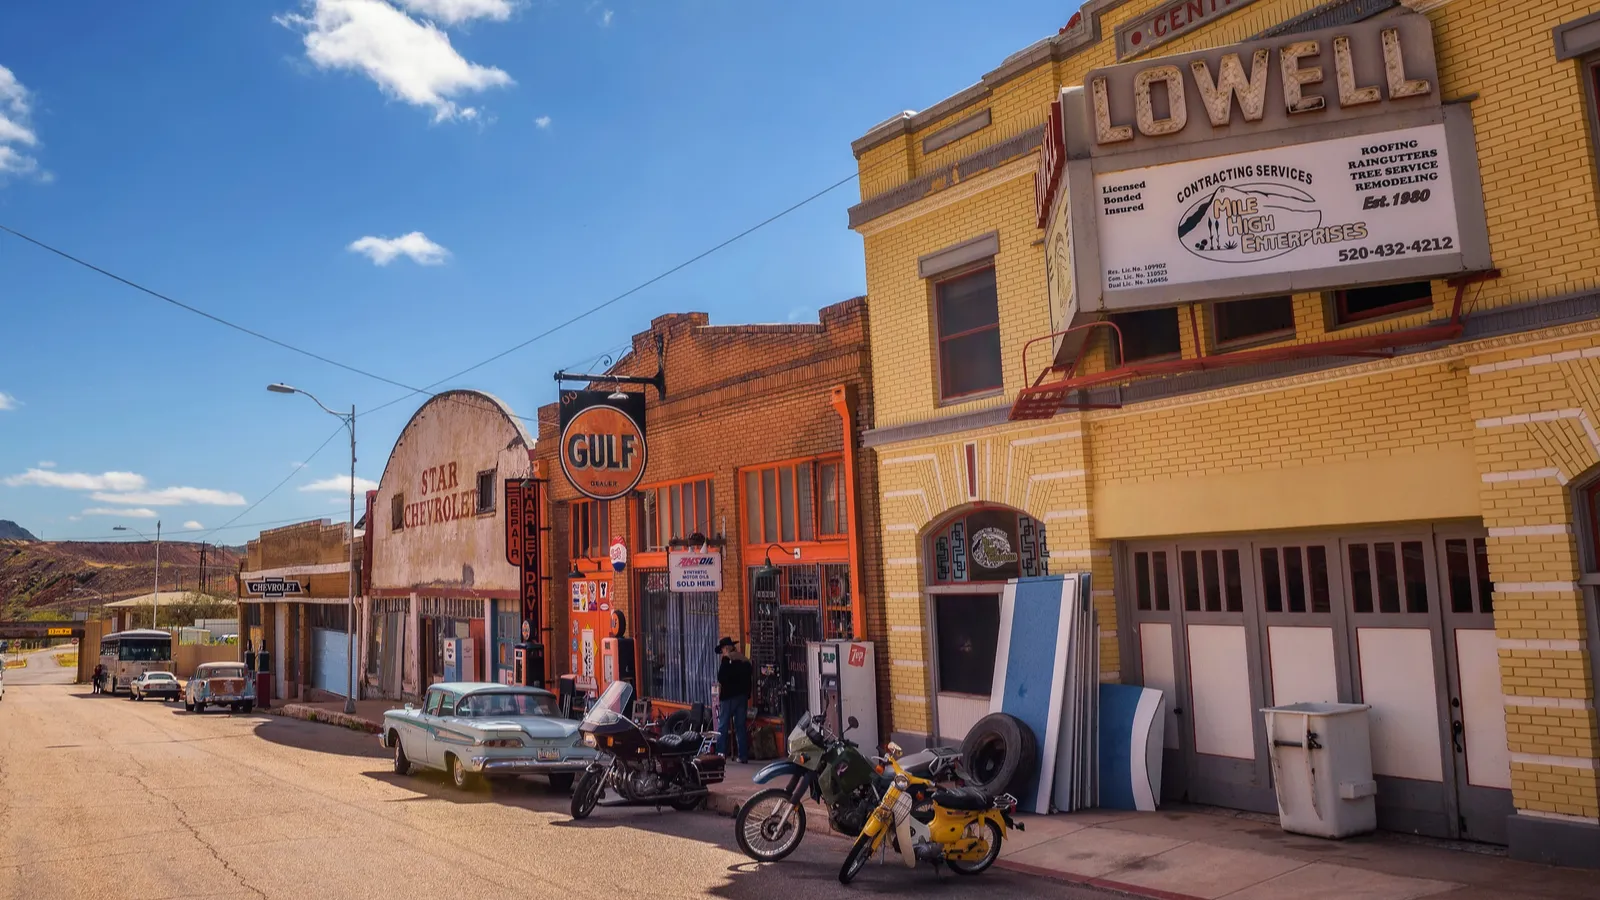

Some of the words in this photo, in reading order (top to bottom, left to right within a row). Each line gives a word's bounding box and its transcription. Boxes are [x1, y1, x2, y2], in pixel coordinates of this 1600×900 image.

[1154, 0, 1230, 37] CEN
[1091, 27, 1431, 145] LOWELL
[1361, 140, 1418, 155] ROOFING
[1348, 149, 1438, 169] RAINGUTTERS
[1350, 169, 1382, 180] TREE
[1385, 161, 1438, 175] SERVICE
[1355, 172, 1438, 191] REMODELING
[1102, 181, 1146, 194] Licensed
[1176, 165, 1253, 203] CONTRACTING
[1256, 164, 1313, 185] SERVICES
[1103, 192, 1141, 205] Bonded
[1104, 203, 1144, 216] Insured
[1213, 197, 1258, 219] MILE
[1362, 195, 1390, 210] Est.
[1392, 188, 1431, 206] 1980
[1226, 214, 1275, 237] HIGH
[1241, 221, 1368, 254] ENTERPRISES
[1338, 236, 1453, 262] 520-432-4212
[568, 433, 638, 471] GULF
[421, 461, 458, 496] STAR
[404, 488, 476, 529] CHEVROLET
[510, 498, 519, 559] REPAIR
[524, 486, 536, 566] HARLEY
[679, 557, 714, 567] AMSOIL
[252, 583, 296, 592] CHEVROLET
